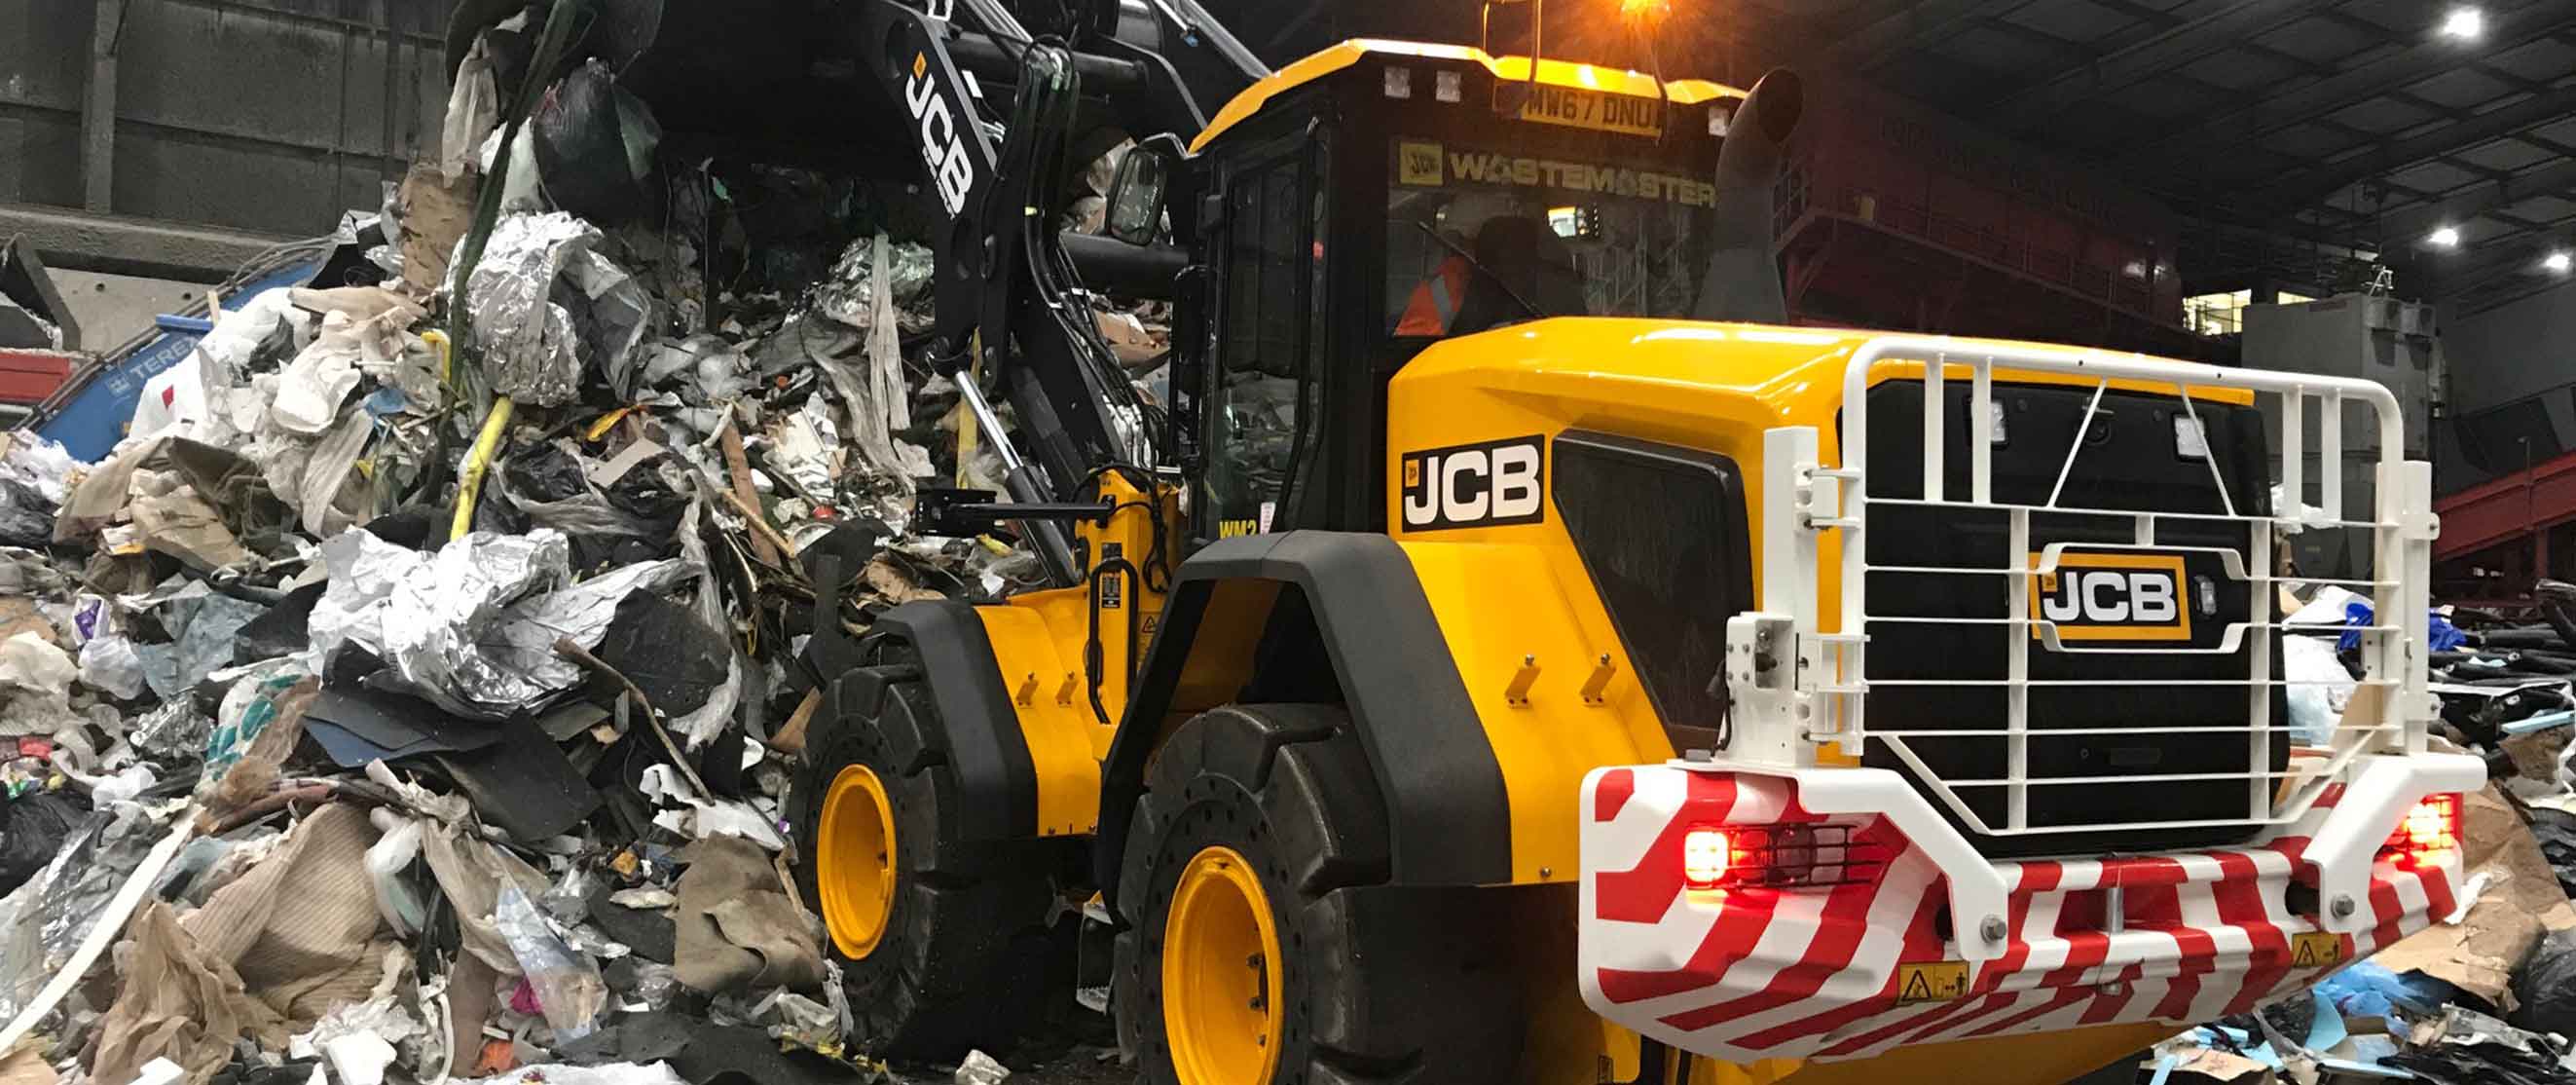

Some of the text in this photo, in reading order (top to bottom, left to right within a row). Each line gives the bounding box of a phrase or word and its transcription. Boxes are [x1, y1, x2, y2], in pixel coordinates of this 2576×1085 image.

[1527, 88, 1651, 129] MW67 DNU
[905, 73, 974, 214] JCB
[1449, 152, 1716, 209] WASTEMASTER
[1405, 444, 1540, 525] JCB
[1219, 519, 1257, 539] WM2
[2042, 572, 2177, 621] JCB
